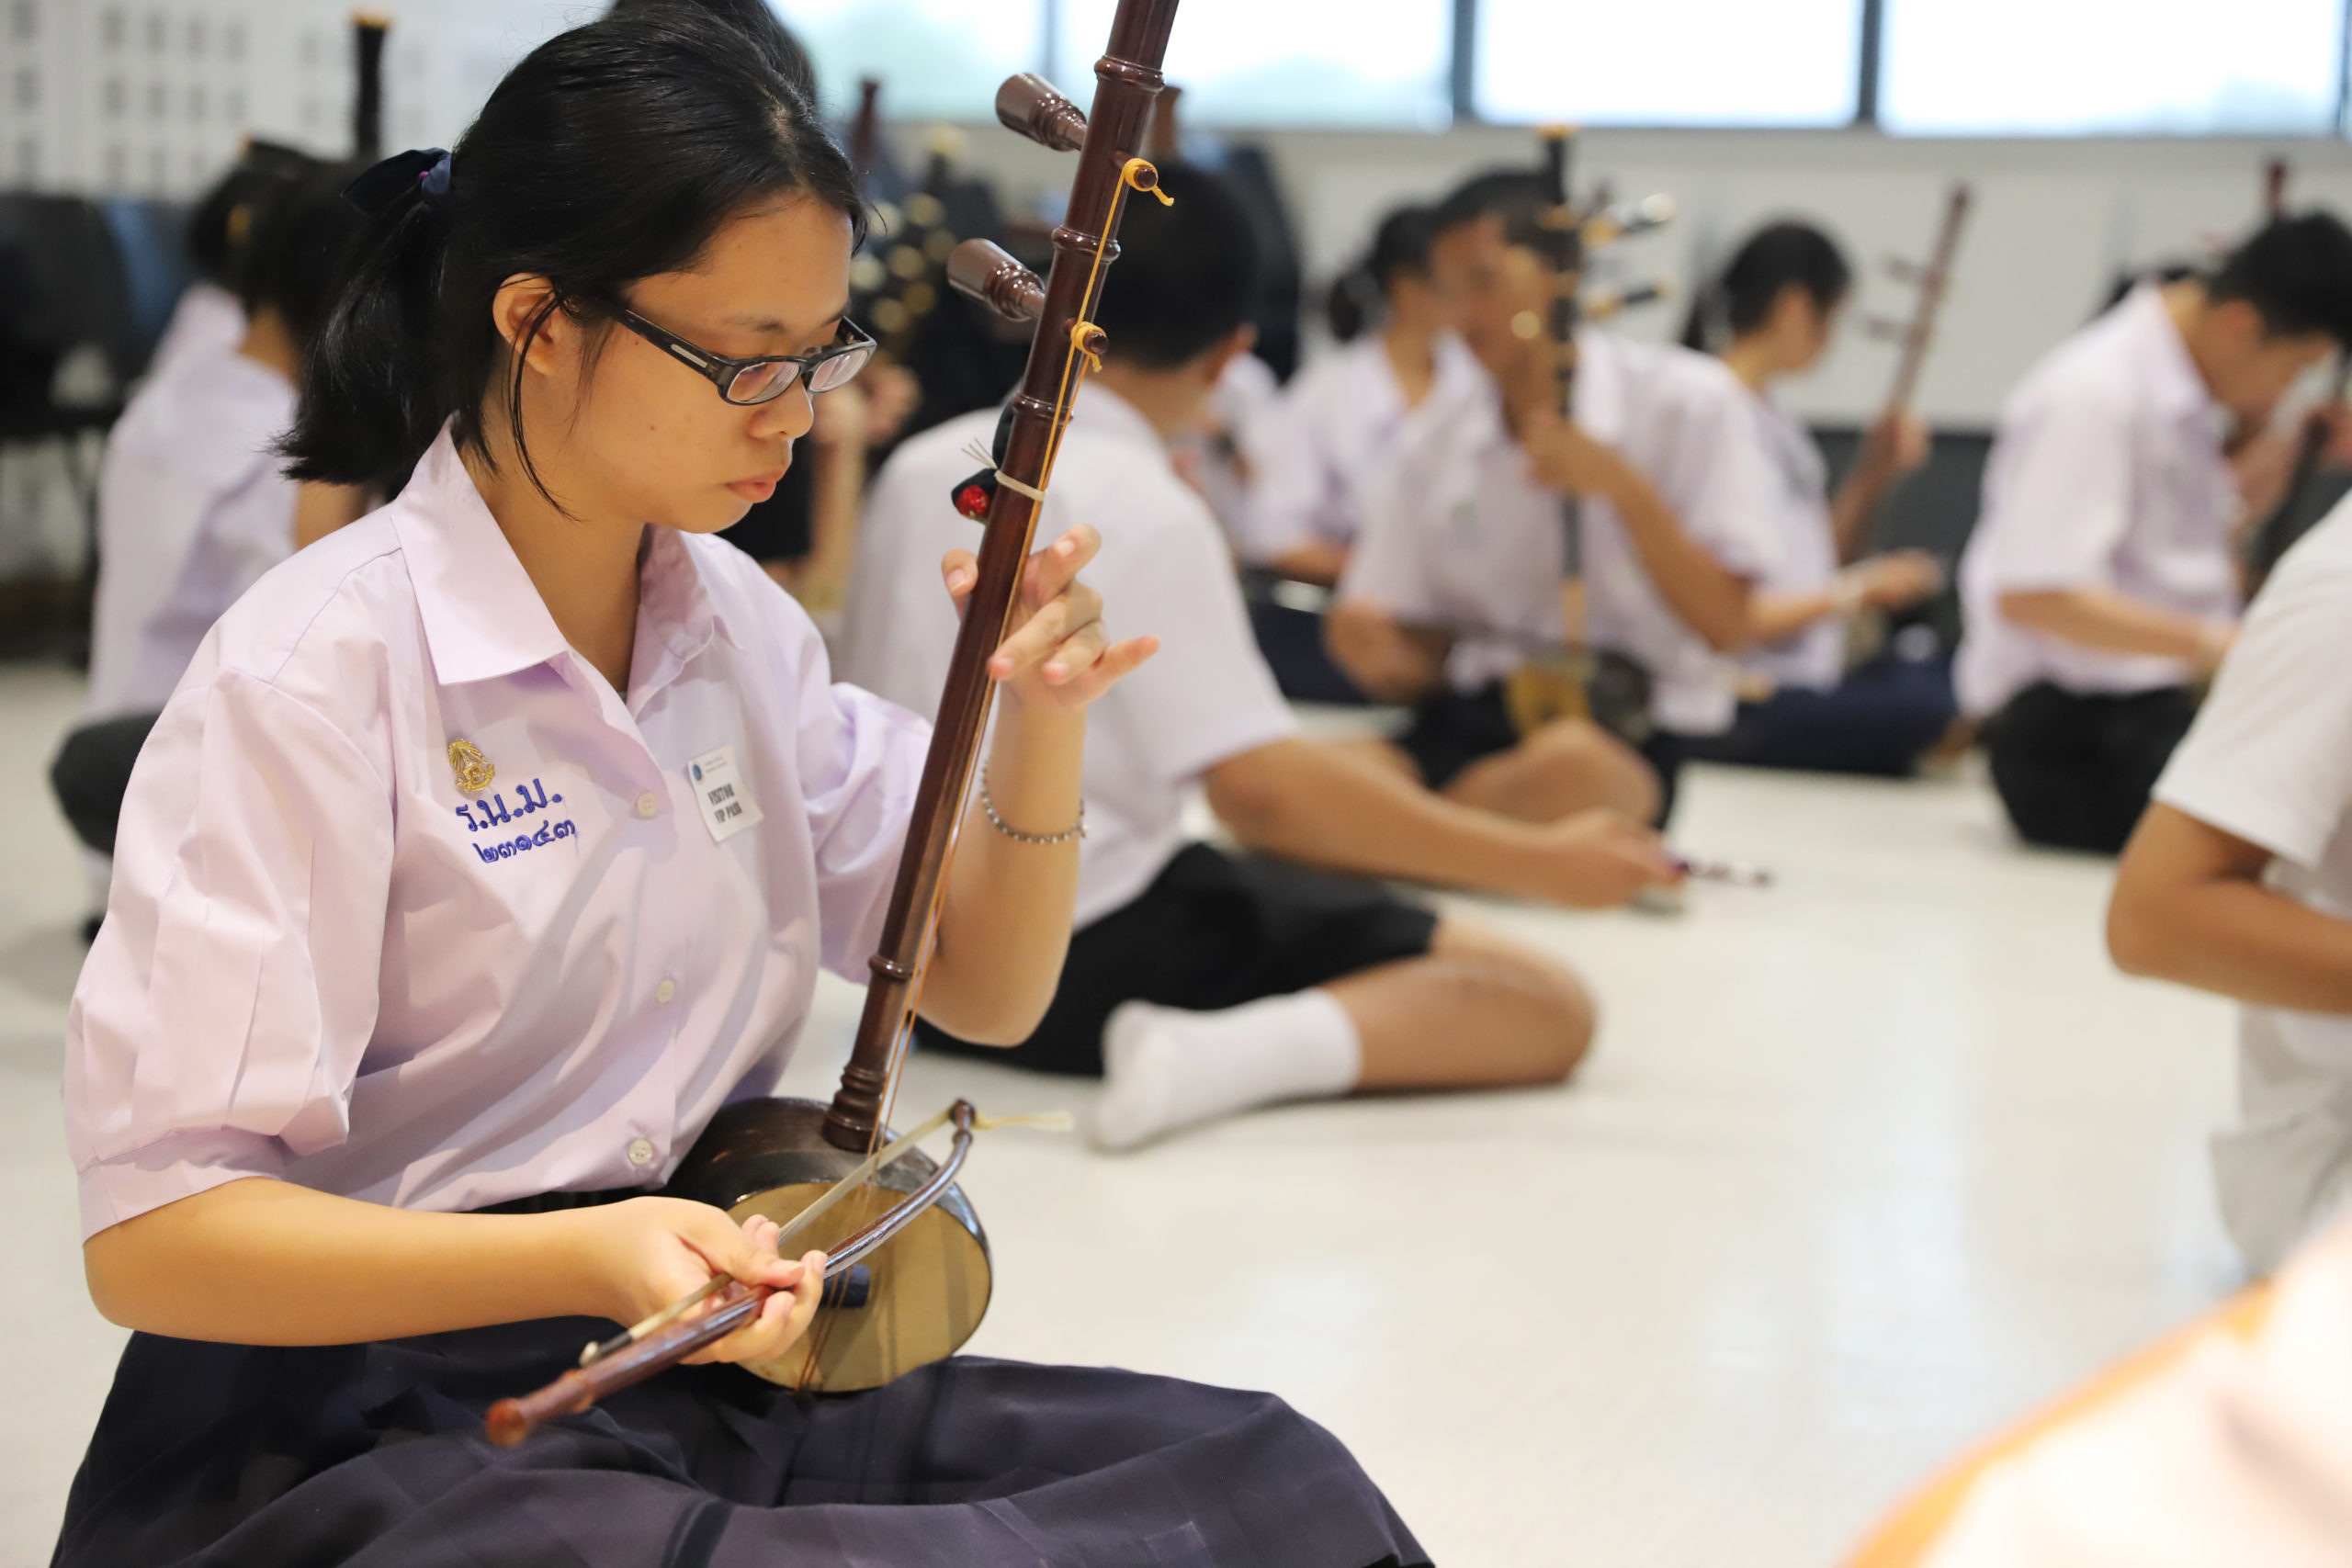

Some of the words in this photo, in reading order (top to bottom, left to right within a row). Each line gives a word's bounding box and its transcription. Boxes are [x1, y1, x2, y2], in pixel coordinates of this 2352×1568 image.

[456, 778, 562, 831] ร.น.ม.
[707, 783, 735, 806] VISITOR
[714, 808, 726, 824] VIP
[725, 801, 742, 819] PASS
